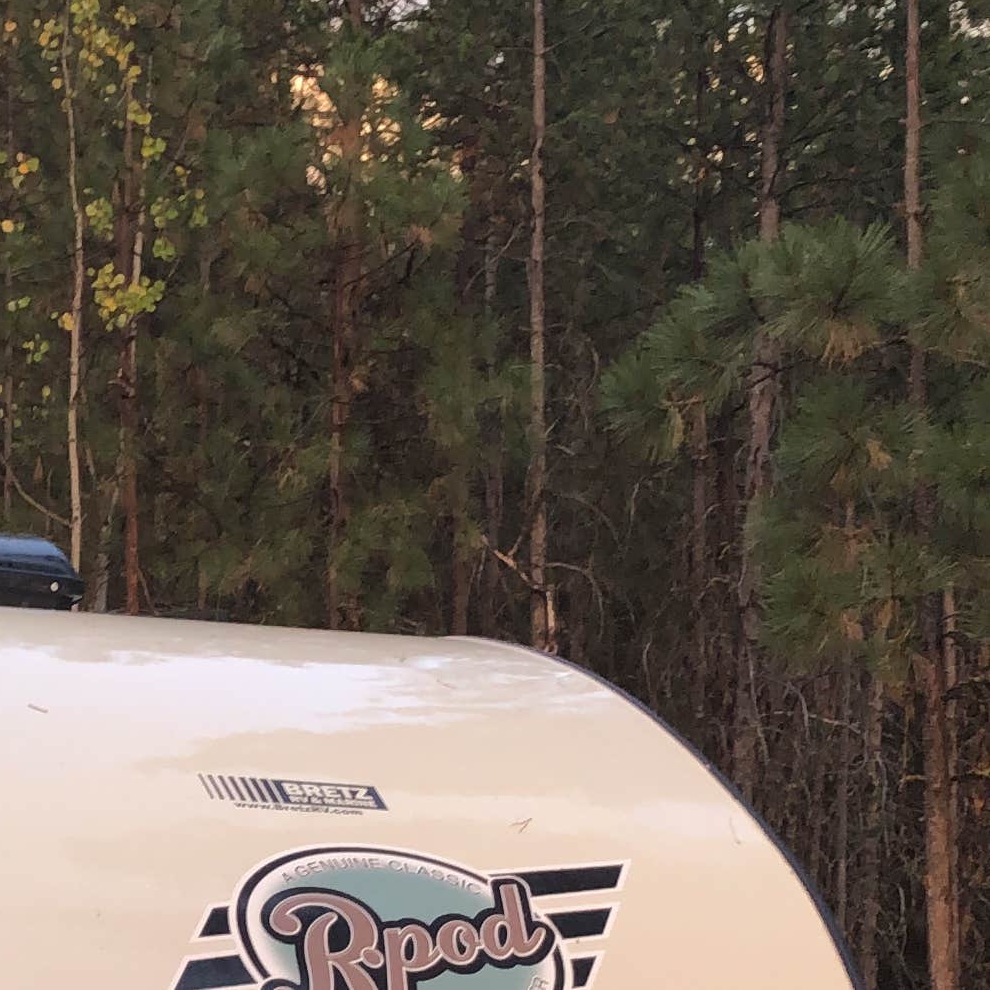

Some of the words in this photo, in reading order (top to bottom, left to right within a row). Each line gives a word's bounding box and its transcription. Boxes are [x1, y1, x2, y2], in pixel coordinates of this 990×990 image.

[280, 782, 375, 801] BRETZ
[294, 857, 381, 877] GENUINE
[388, 859, 482, 896] CLASSIC
